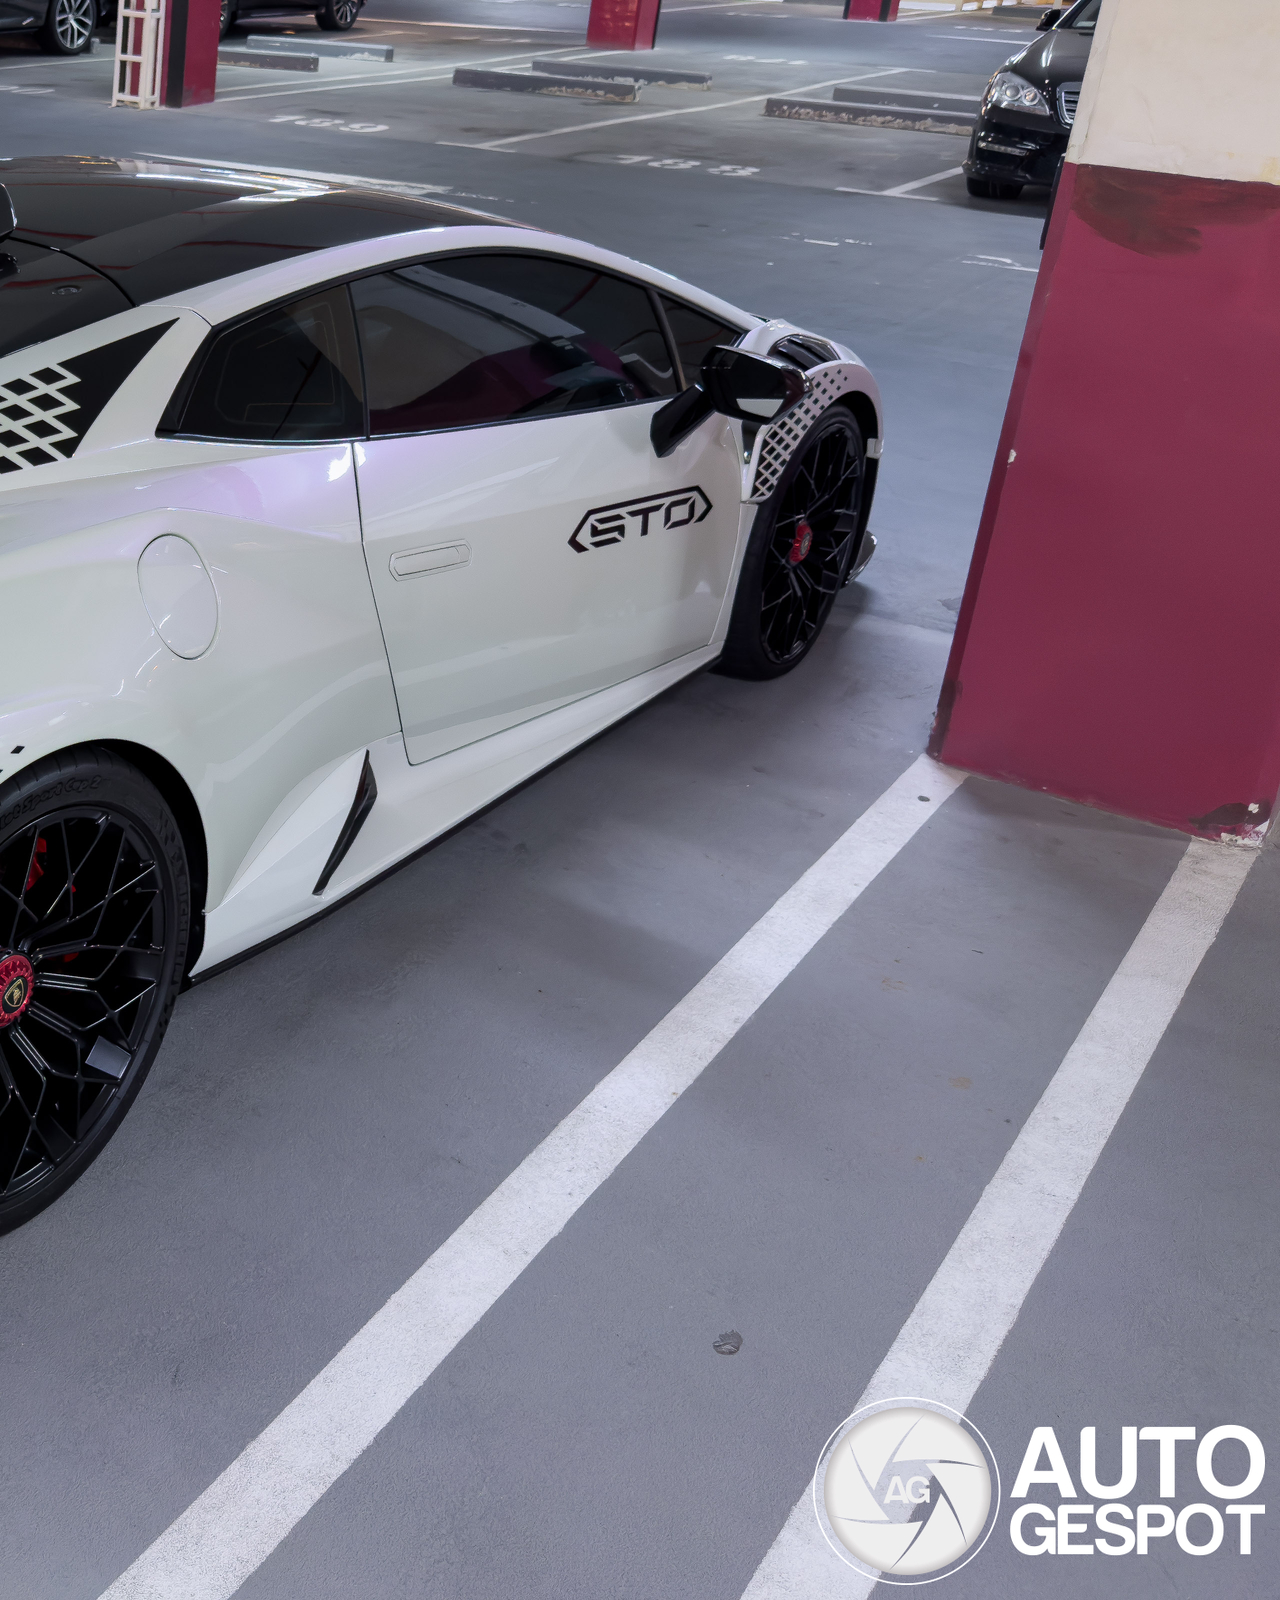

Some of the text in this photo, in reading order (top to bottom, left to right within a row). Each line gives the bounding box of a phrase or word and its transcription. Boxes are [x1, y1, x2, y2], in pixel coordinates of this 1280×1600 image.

[268, 114, 389, 133] 189
[616, 154, 761, 177] 188
[589, 496, 696, 548] STO
[21, 781, 64, 814] Sport
[64, 776, 89, 794] Cup
[89, 774, 102, 790] 2
